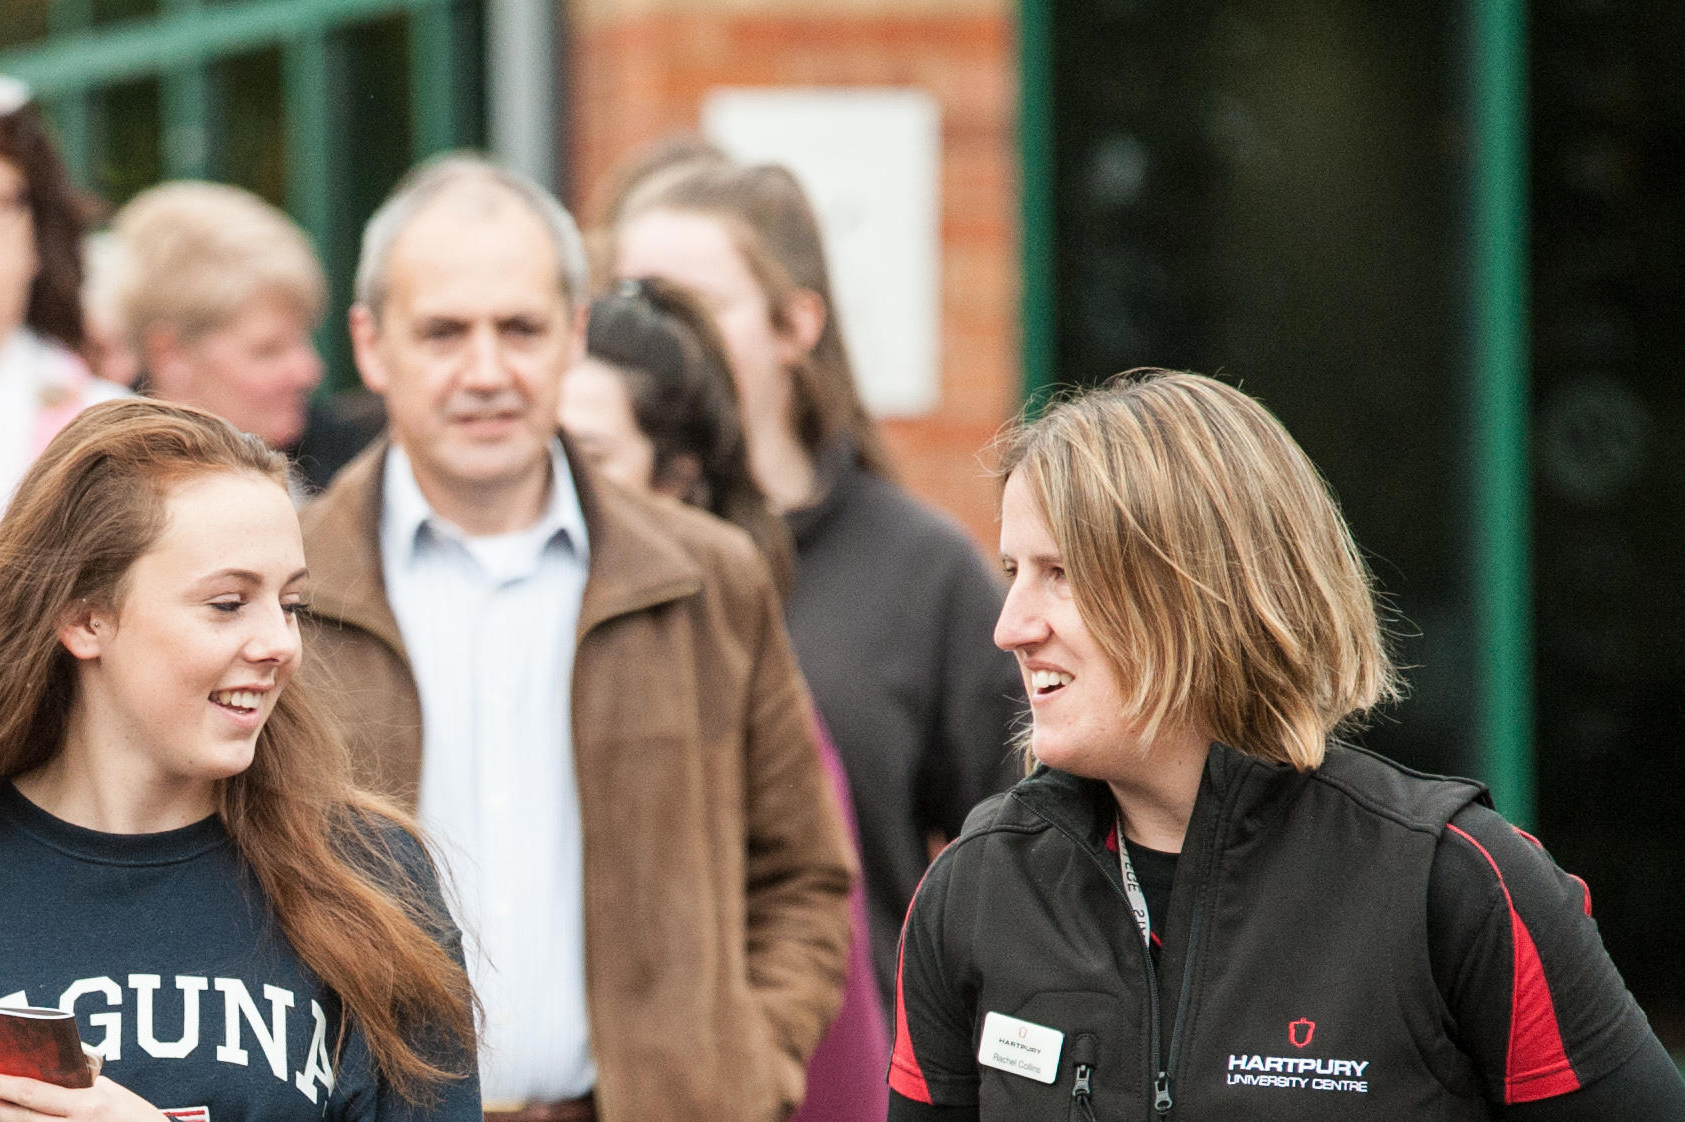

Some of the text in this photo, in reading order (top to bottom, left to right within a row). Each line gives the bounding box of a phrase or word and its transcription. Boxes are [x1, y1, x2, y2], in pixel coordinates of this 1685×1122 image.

[998, 1037, 1042, 1055] HARTPURY
[1228, 1054, 1370, 1077] HARTPURY
[1227, 1073, 1368, 1093] UNIVERSITY CENTRE
